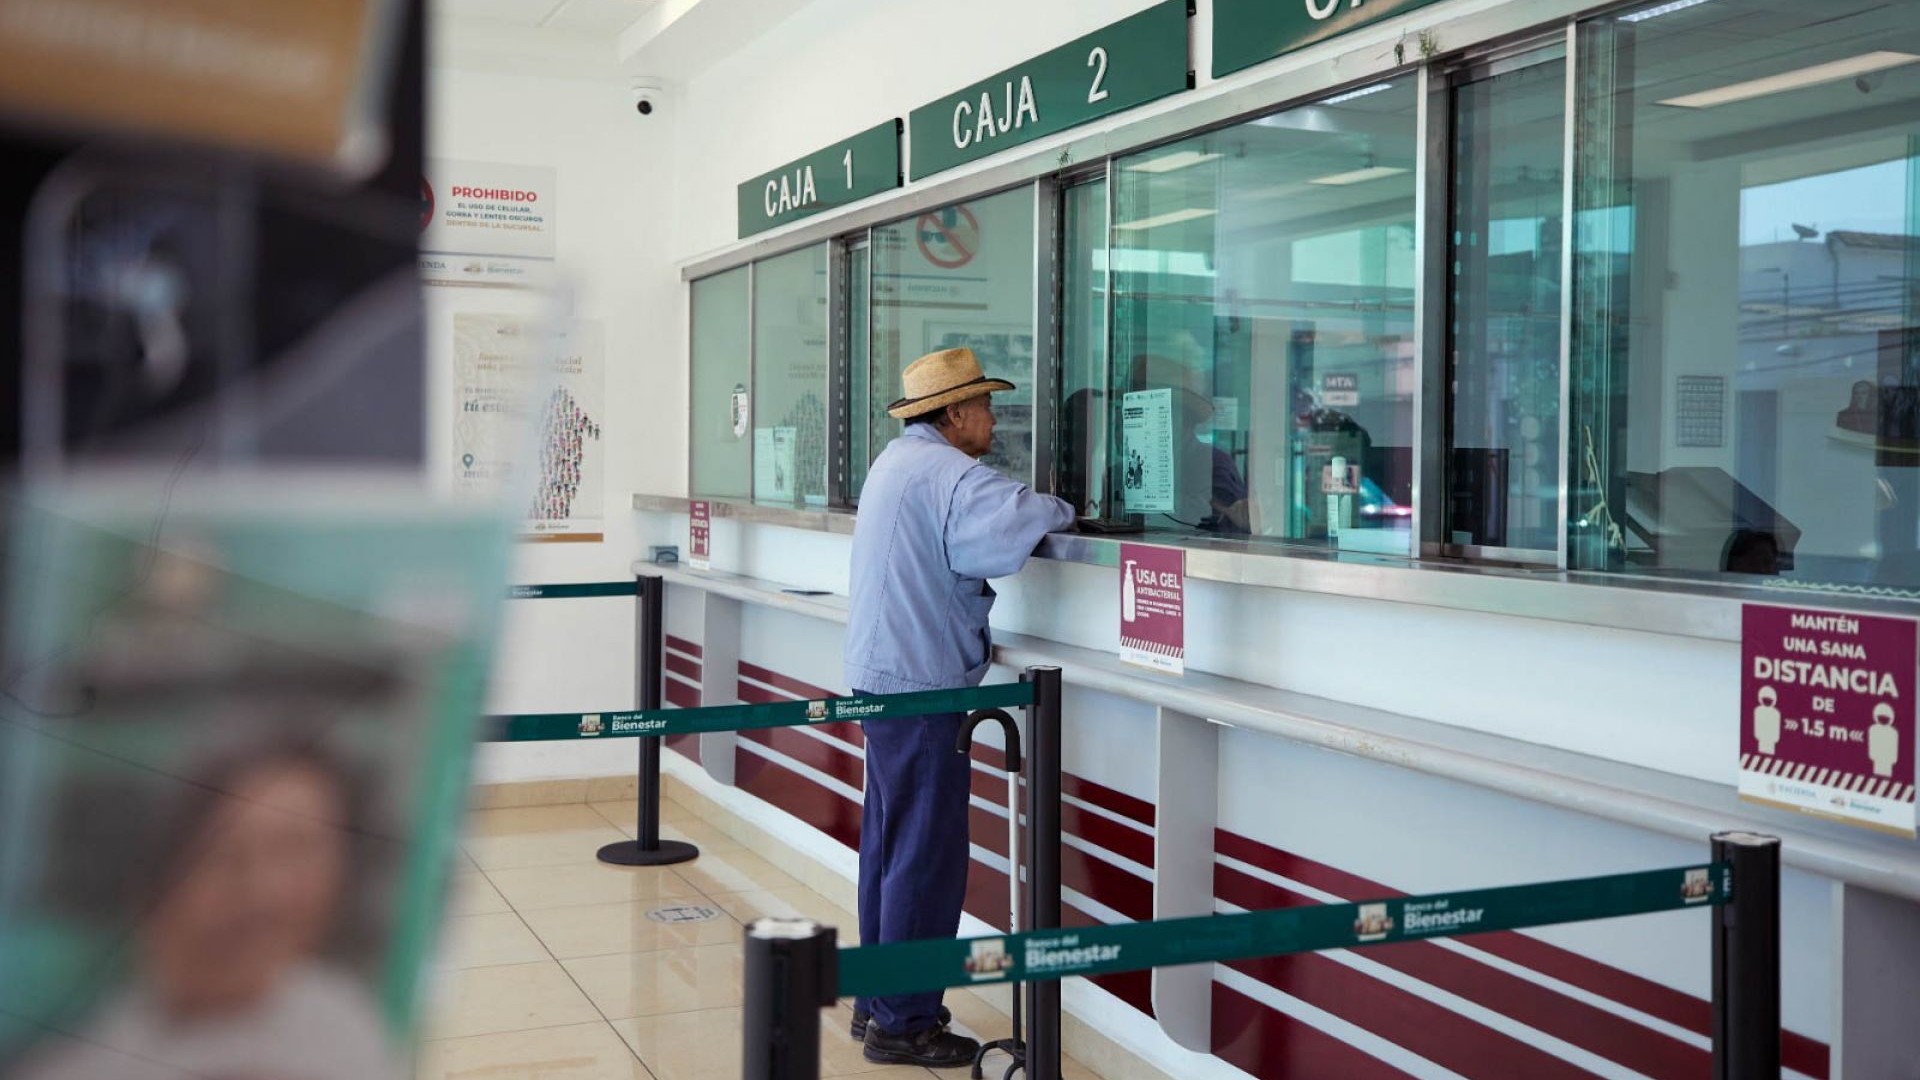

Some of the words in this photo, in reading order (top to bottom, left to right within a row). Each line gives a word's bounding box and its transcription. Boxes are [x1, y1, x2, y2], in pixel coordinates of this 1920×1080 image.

[953, 75, 1039, 149] CAJA
[1087, 46, 1109, 104] 2
[765, 165, 817, 218] CAJA
[843, 148, 853, 190] 1
[452, 186, 537, 202] PROHIBIDO
[446, 211, 472, 219] GORRA
[480, 213, 507, 221] LENTES
[509, 214, 543, 222] OSCUROS
[1136, 569, 1158, 586] USA
[1160, 572, 1181, 589] GEL
[1791, 614, 1859, 635] MANTÉN
[1783, 636, 1817, 654] UNA
[1821, 641, 1867, 661] SANA
[1754, 656, 1899, 698] DISTANCIA
[835, 703, 885, 716] Bienestar
[1812, 695, 1835, 713] DE
[612, 719, 668, 731] Bienestar
[1801, 718, 1825, 738] 1.5
[1829, 727, 1848, 742] m
[1404, 902, 1432, 912] Banco
[1434, 900, 1449, 910] del
[1403, 907, 1484, 930] Bienestar
[1025, 937, 1061, 949] Banco
[1062, 934, 1079, 946] del
[1025, 944, 1122, 969] Bienestar
